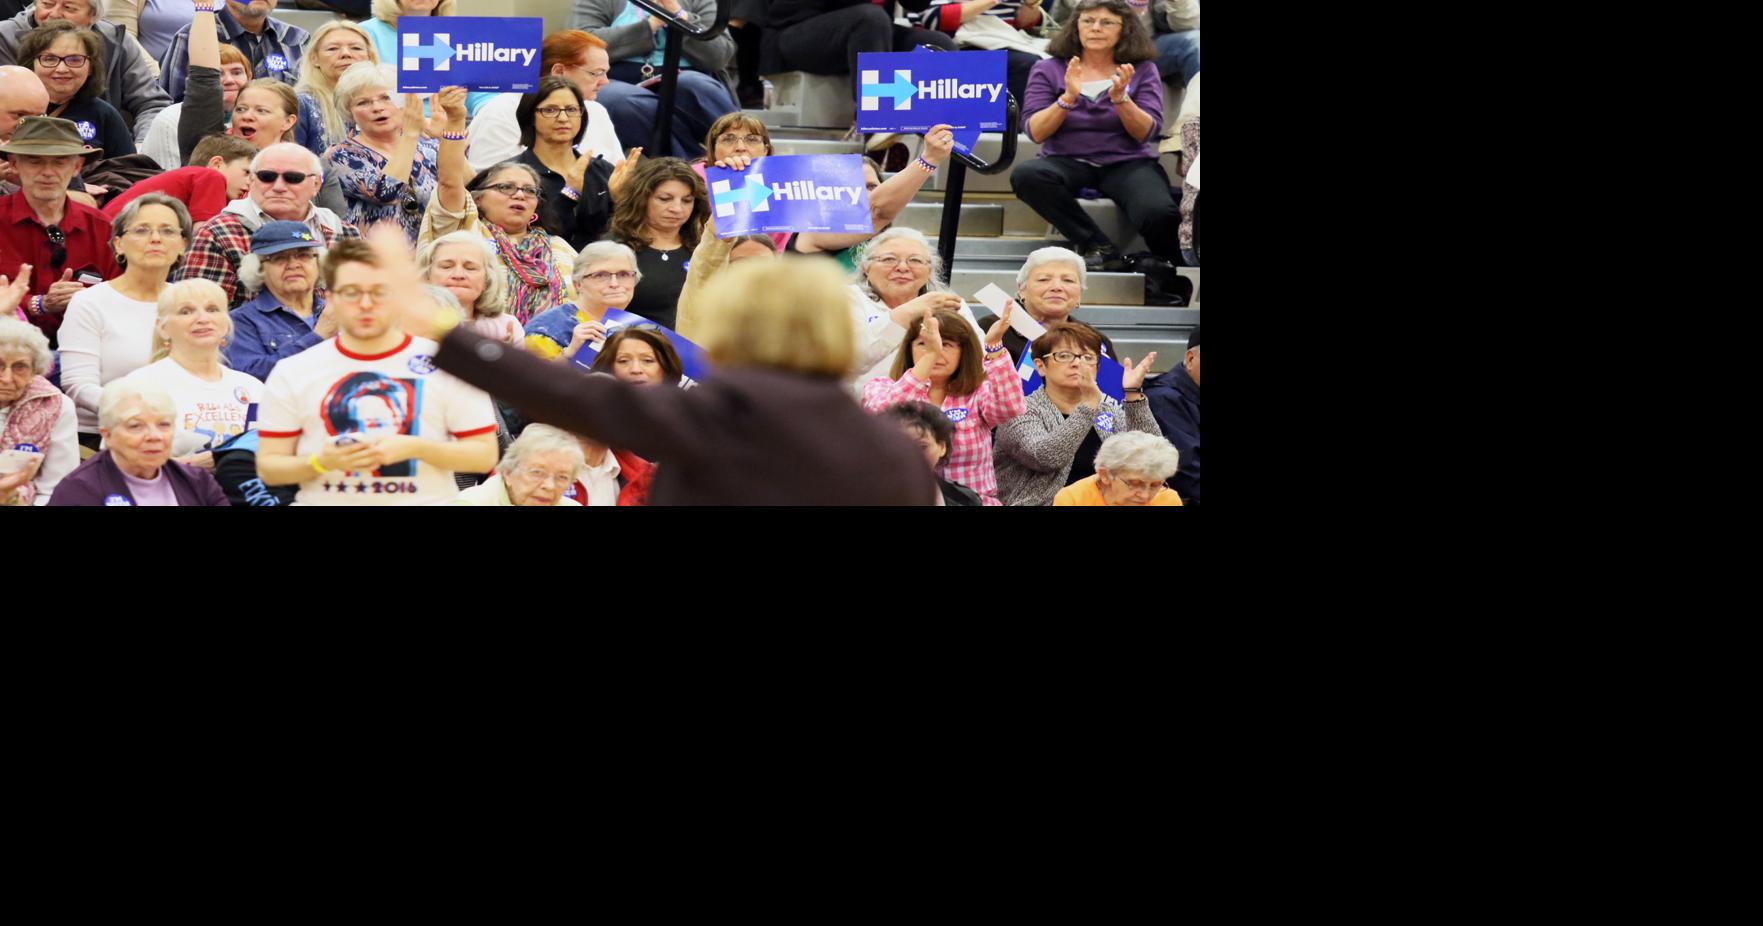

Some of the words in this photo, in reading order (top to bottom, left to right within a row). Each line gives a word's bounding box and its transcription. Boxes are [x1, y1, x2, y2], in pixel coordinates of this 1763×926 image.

[455, 42, 537, 67] Hillary
[917, 78, 1004, 103] Hillary
[771, 180, 862, 205] Hillary
[371, 481, 417, 494] 2016
